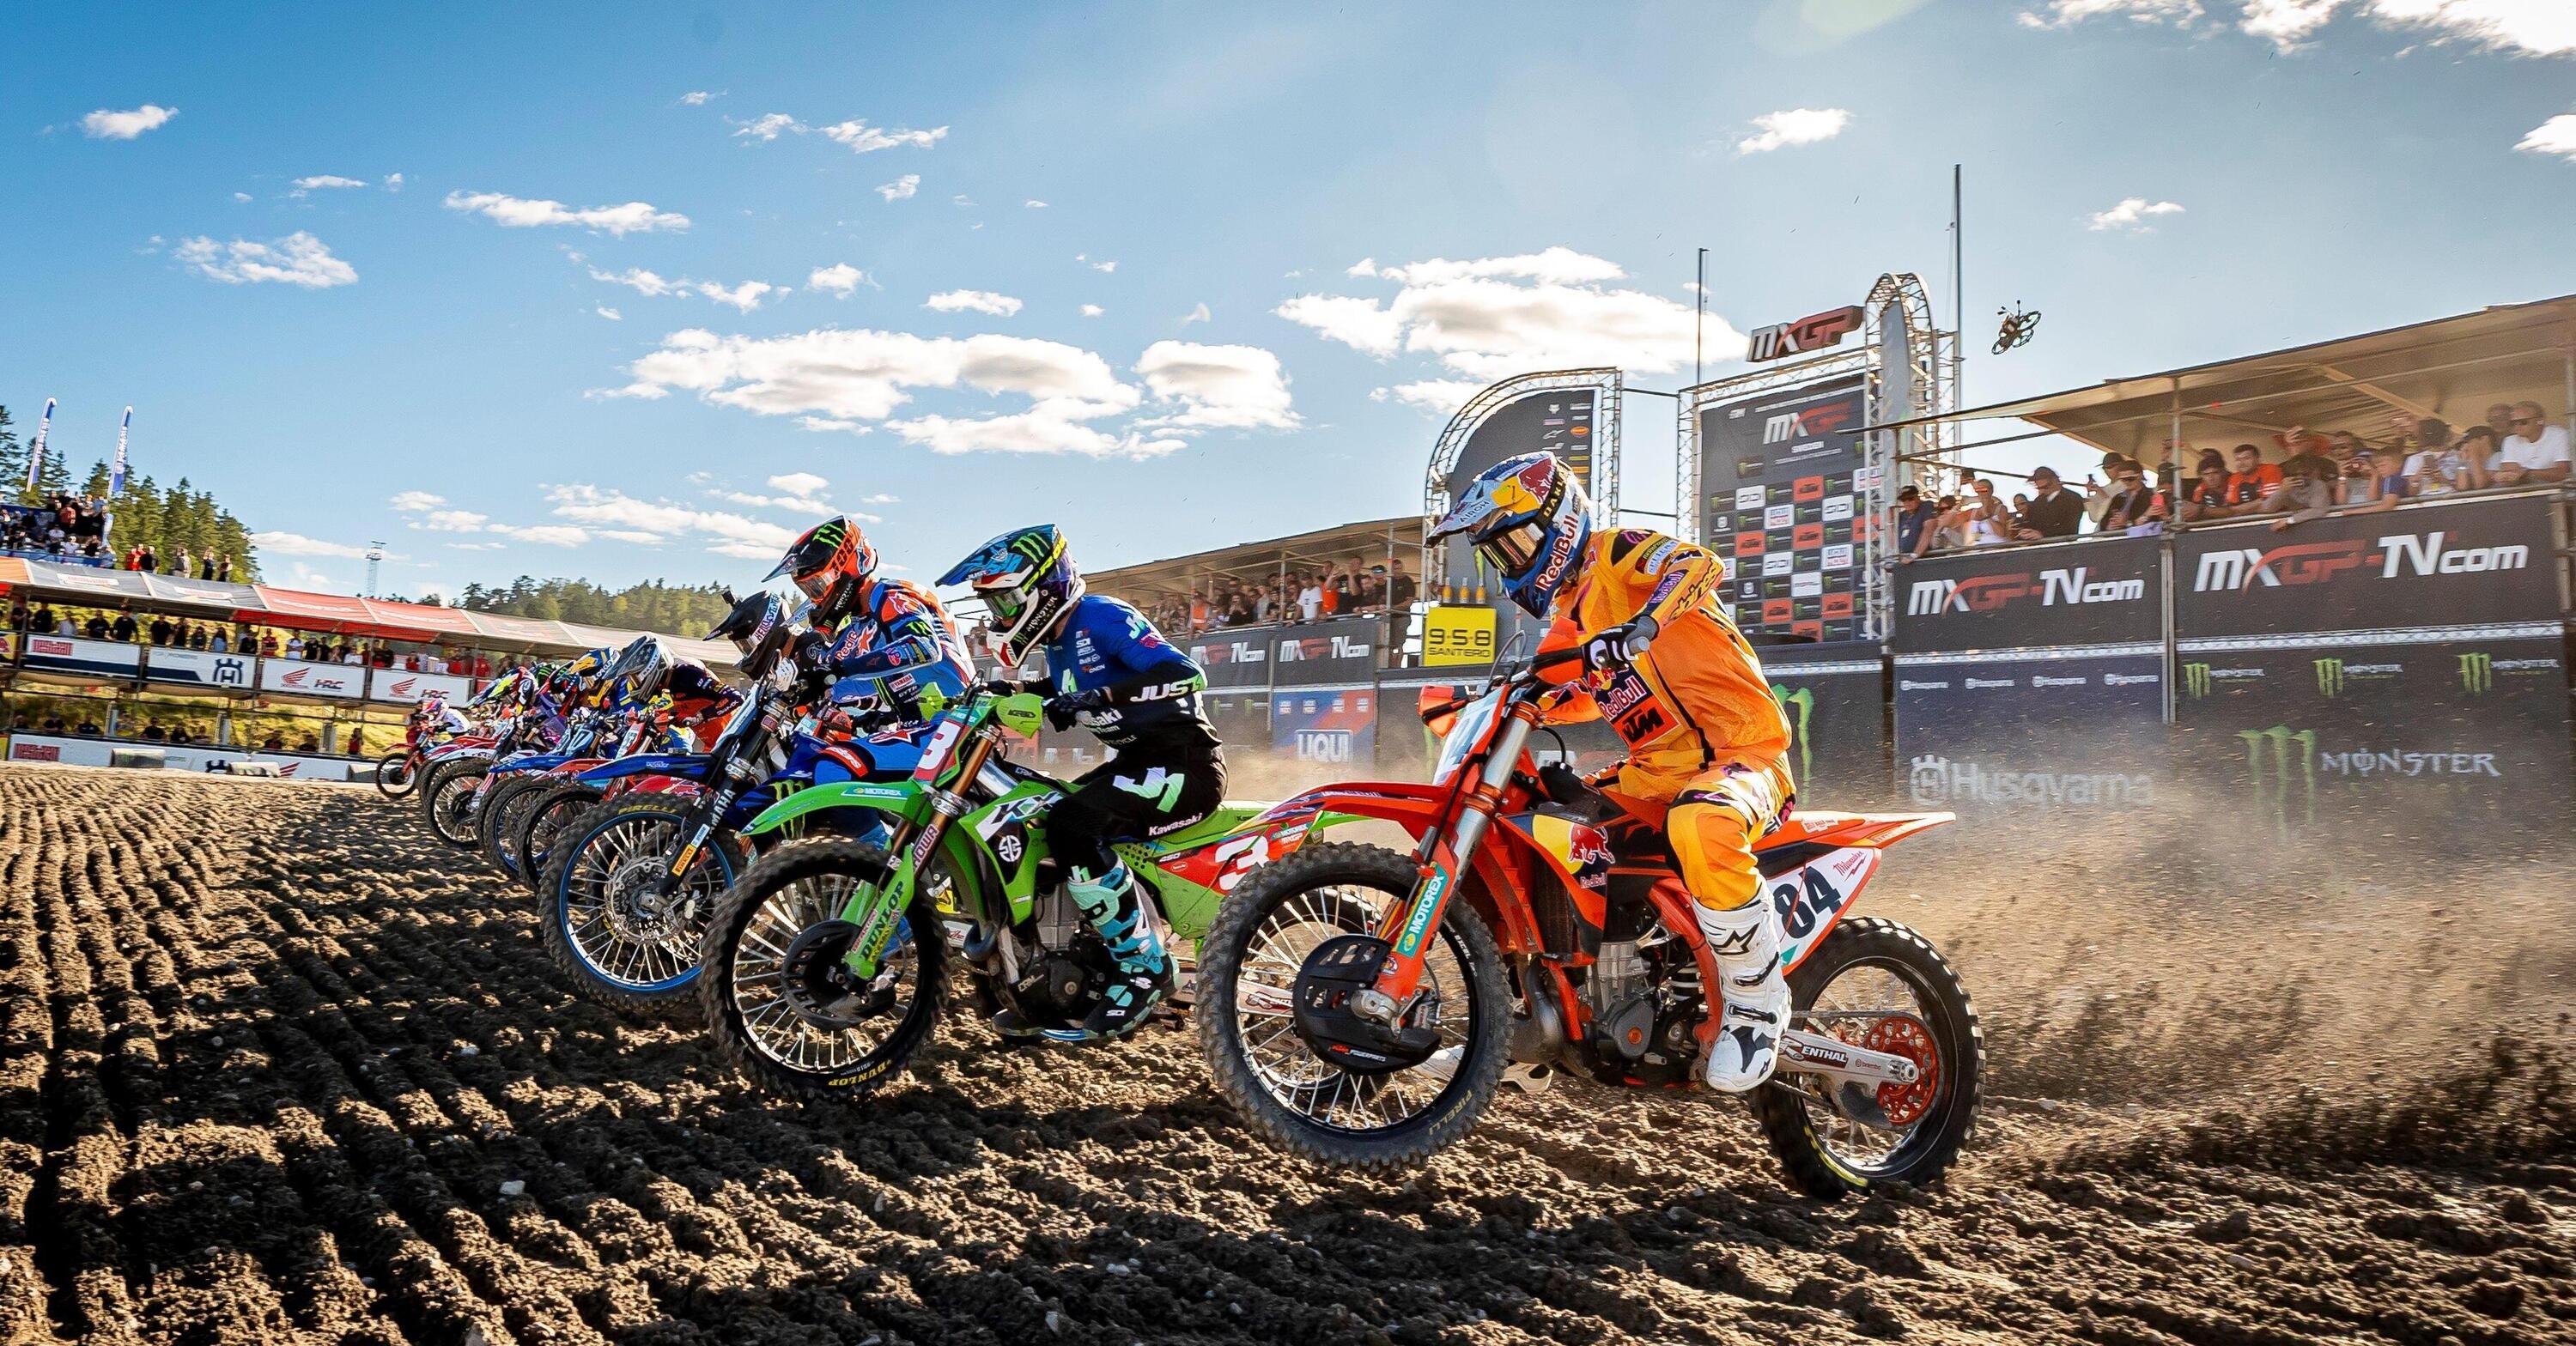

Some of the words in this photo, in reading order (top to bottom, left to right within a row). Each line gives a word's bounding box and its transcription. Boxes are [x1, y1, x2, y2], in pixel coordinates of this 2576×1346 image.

[1460, 500, 1490, 523] AIROH
[1026, 596, 1058, 632] MONSTER
[1428, 646, 1491, 658] SANTERO
[1622, 707, 1665, 744] KTM
[916, 720, 963, 770] 3
[1297, 733, 1351, 763] LIQUI
[2322, 748, 2502, 777] MONSTER
[617, 804, 678, 815] PIRELLI
[1149, 813, 1203, 836] Kawasaki
[1215, 835, 1270, 890] 3
[1409, 876, 1445, 934] MOTOREX
[1772, 865, 1843, 939] 84
[860, 881, 903, 961] DUNLOP
[829, 1060, 887, 1087] DUNLOP
[1862, 1061, 1881, 1070] brembo
[1429, 1090, 1473, 1136] PIRELLI
